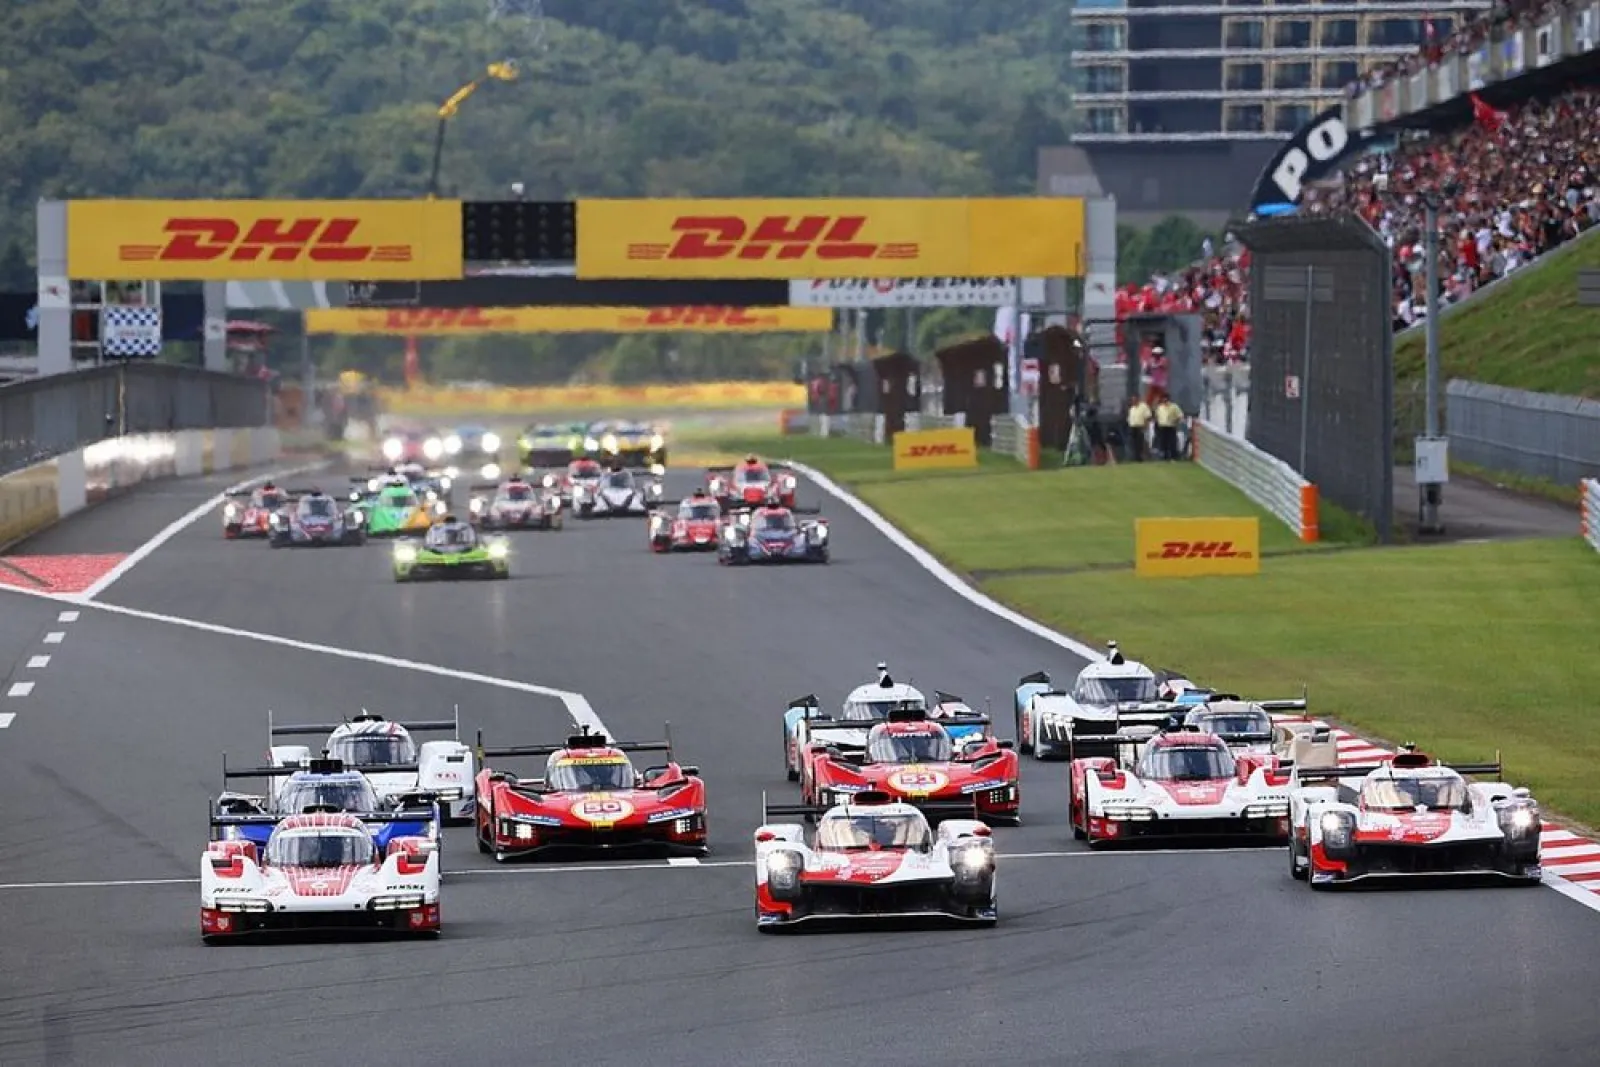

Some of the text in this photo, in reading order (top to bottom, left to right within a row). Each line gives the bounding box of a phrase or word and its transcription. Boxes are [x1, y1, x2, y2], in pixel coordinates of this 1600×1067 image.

[160, 218, 373, 261] DHL
[667, 215, 878, 259] DHL
[645, 305, 757, 325] DHL
[909, 443, 957, 457] DHL
[1161, 541, 1238, 559] DHL
[900, 773, 937, 785] 51
[584, 802, 622, 815] 50
